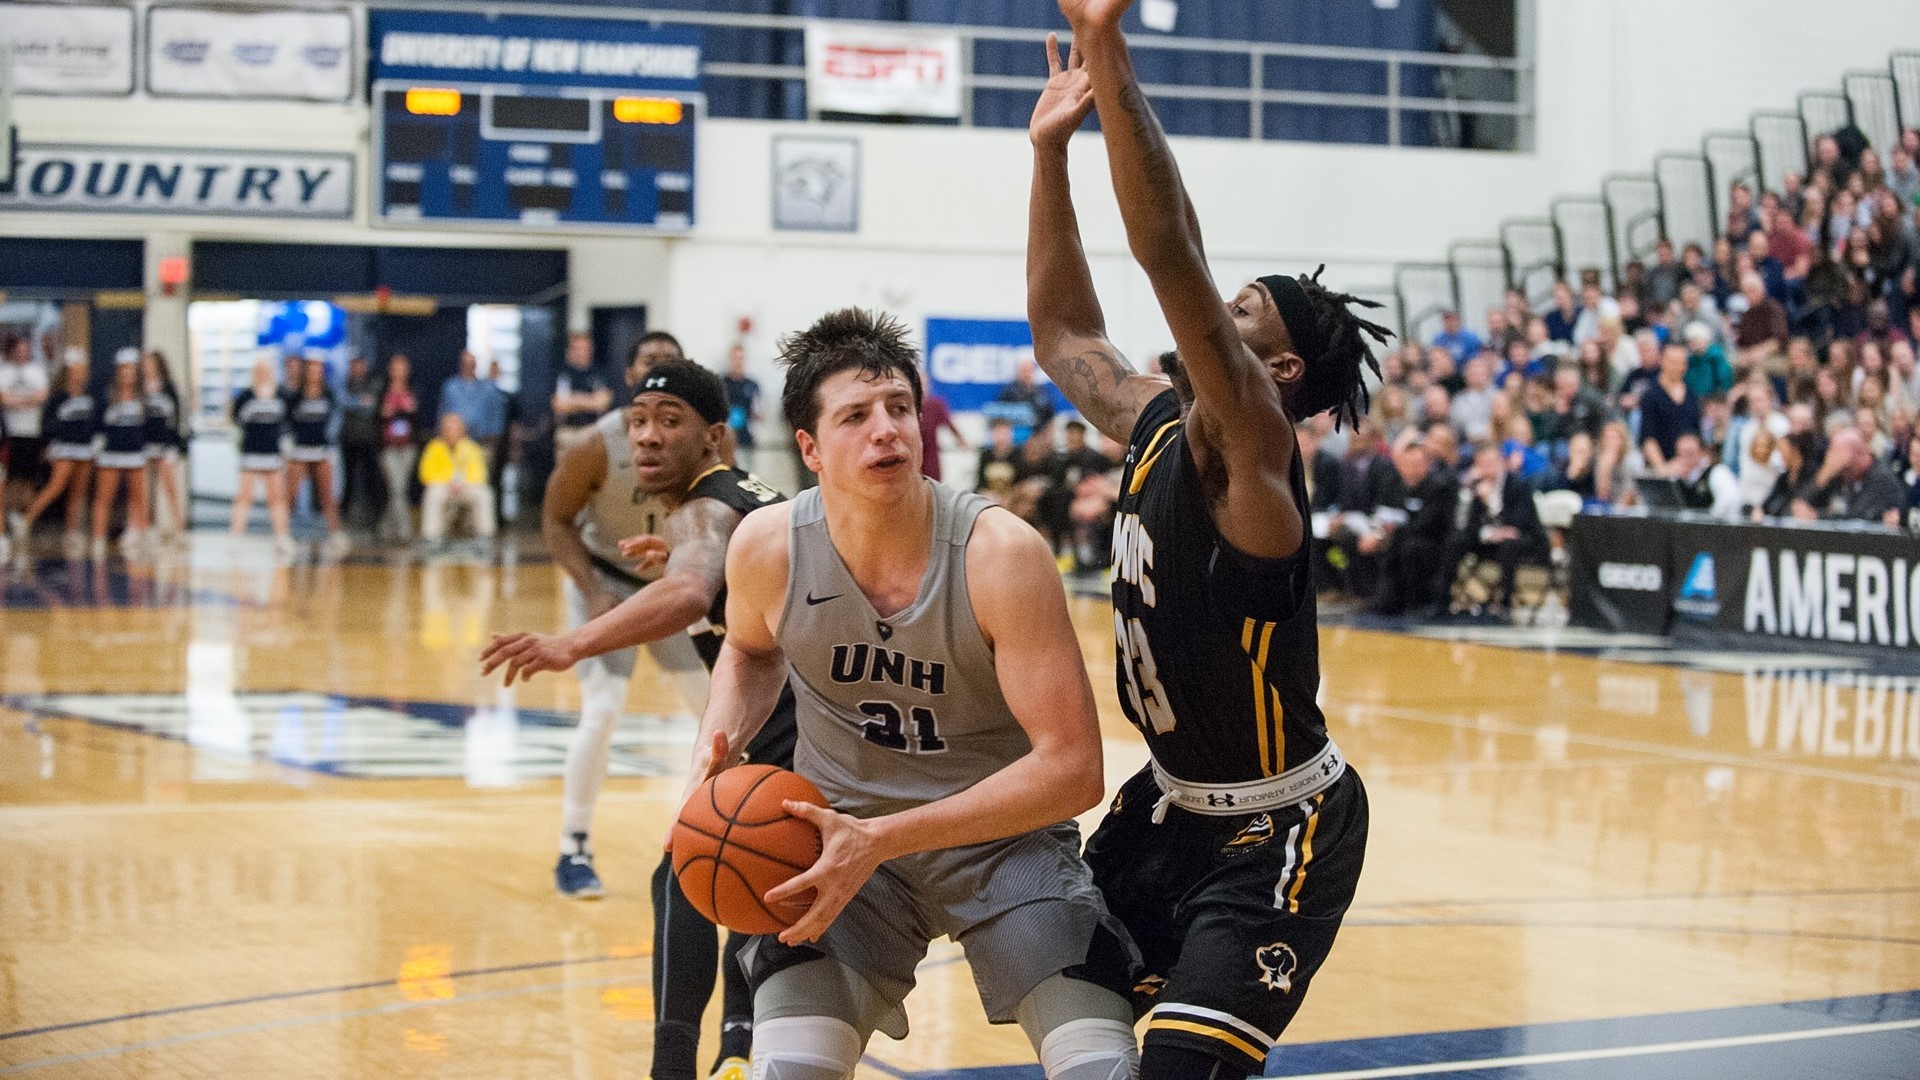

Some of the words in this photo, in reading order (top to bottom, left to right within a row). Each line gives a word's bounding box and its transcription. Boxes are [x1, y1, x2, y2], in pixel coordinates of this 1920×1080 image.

[16, 158, 331, 202] OUNTRY
[1599, 562, 1662, 591] GEICO
[829, 643, 947, 695] UNH
[856, 700, 948, 754] 21
[1239, 787, 1286, 804] ARMOUR
[1289, 772, 1321, 792] UNDER
